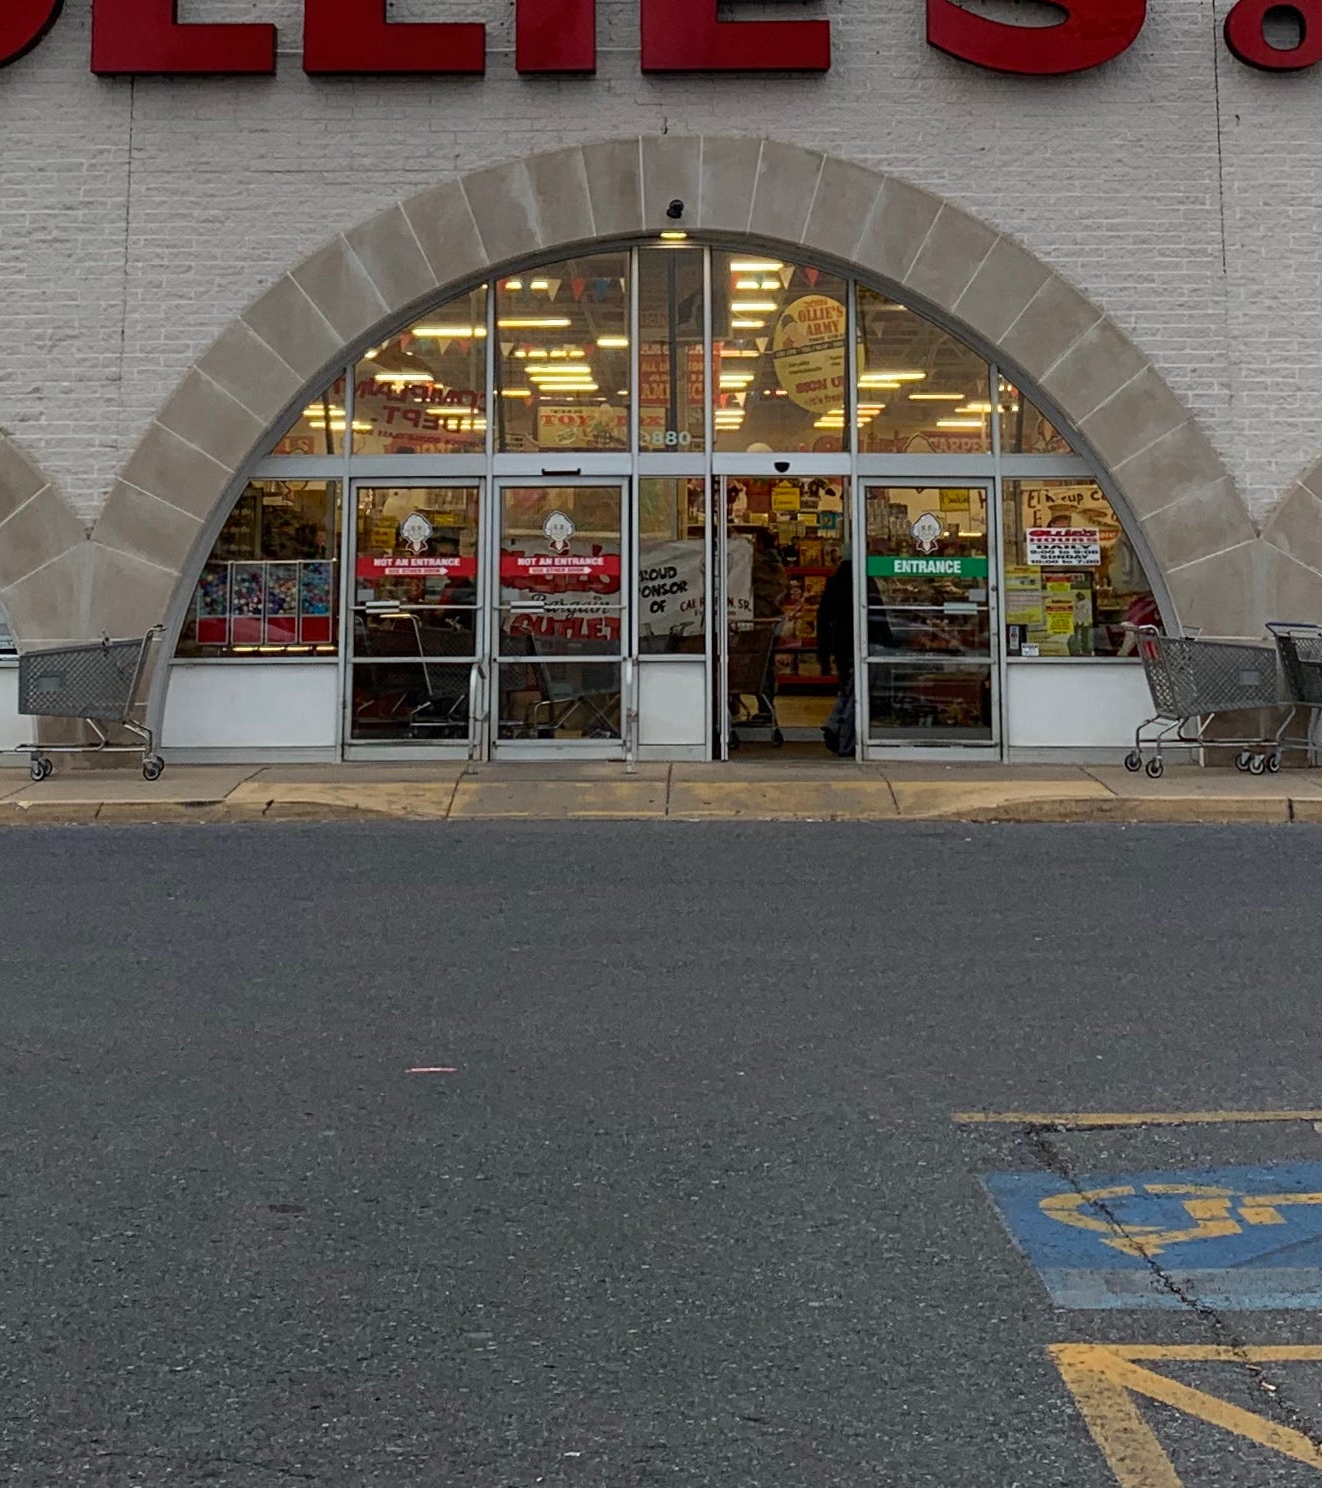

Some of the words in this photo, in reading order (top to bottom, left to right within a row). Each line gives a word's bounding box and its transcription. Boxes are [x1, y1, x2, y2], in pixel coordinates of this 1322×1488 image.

[798, 306, 845, 323] OLLIE'S
[806, 320, 839, 336] ARMY
[540, 415, 596, 427] TOY
[374, 558, 393, 566] NOT
[396, 558, 408, 566] AN
[411, 558, 460, 566] ENTRANCE
[518, 557, 536, 565] NOT
[539, 557, 553, 565] AN
[556, 557, 604, 565] ENTRANCE
[894, 560, 961, 573] ENTRANCE
[649, 599, 667, 614] OF
[679, 599, 697, 612] CAL
